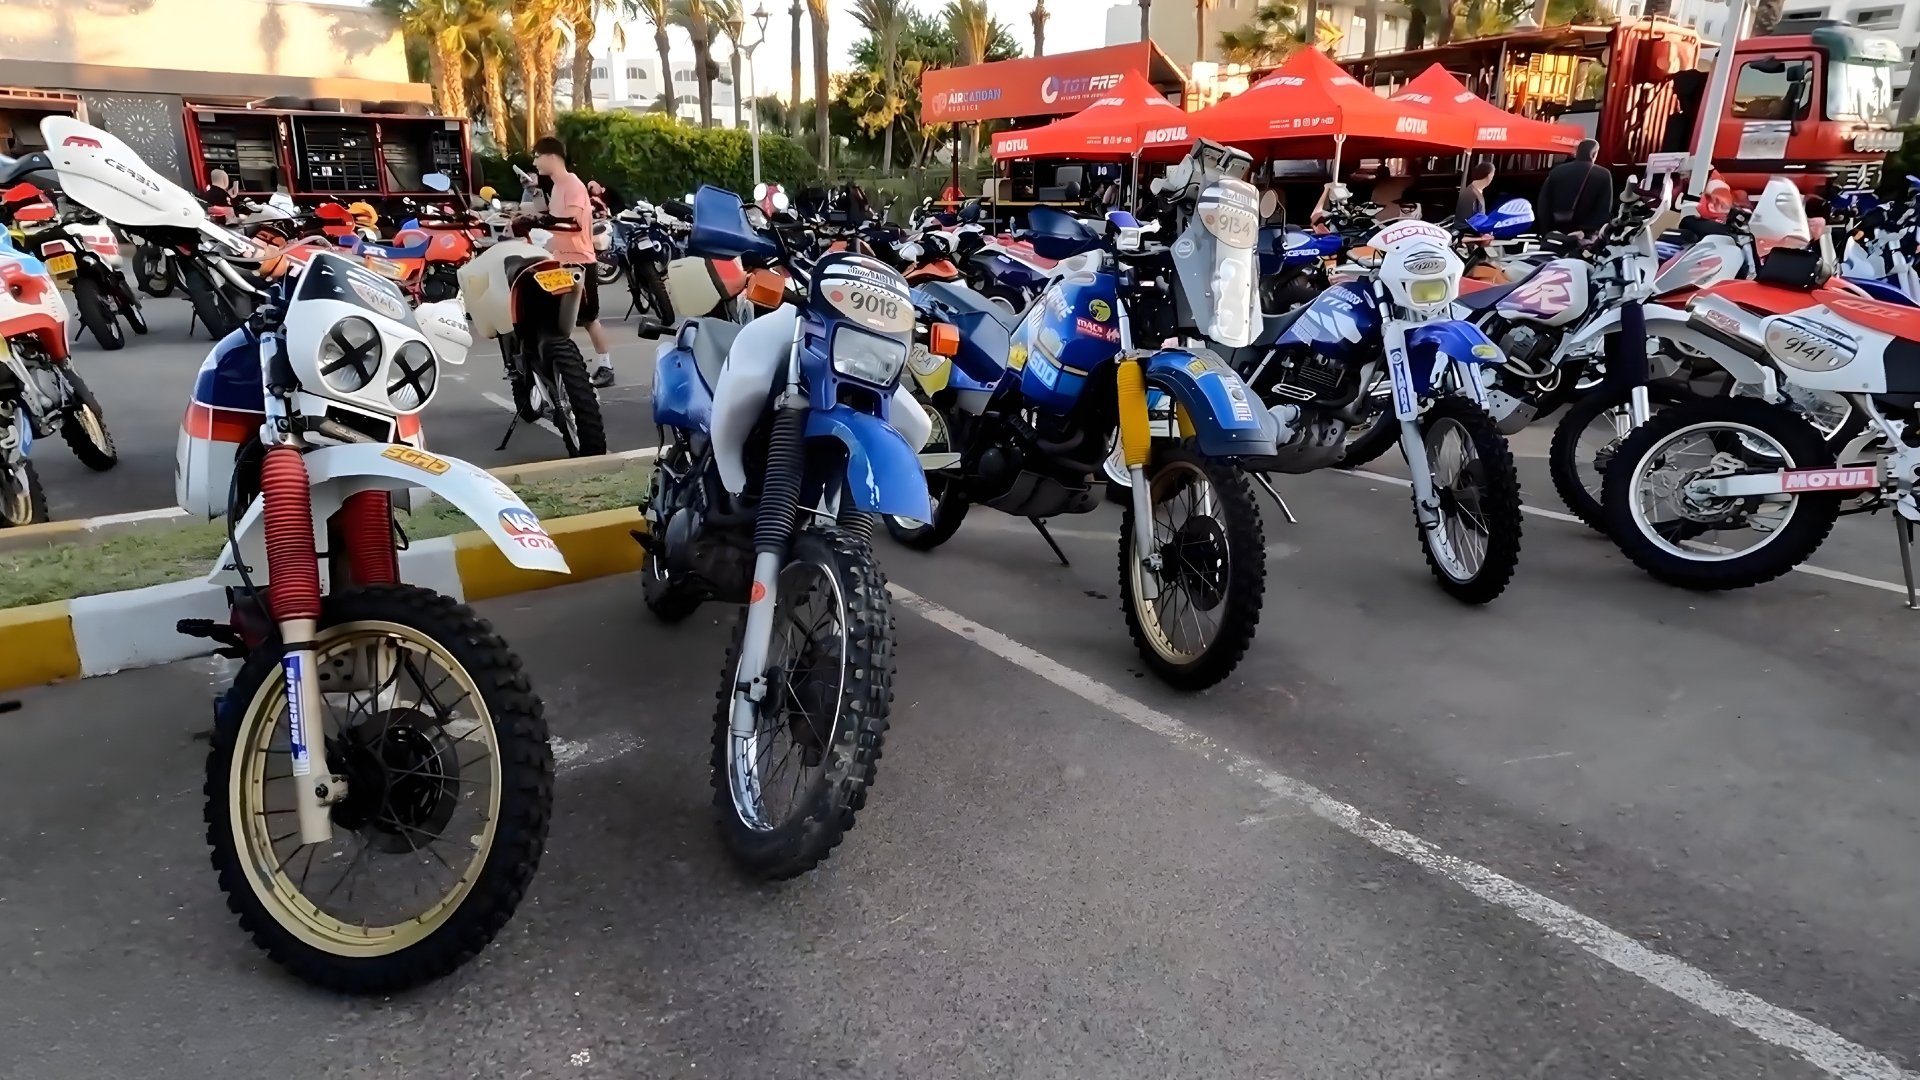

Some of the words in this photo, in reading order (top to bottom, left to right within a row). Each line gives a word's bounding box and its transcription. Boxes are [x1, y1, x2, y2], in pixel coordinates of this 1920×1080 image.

[1395, 116, 1428, 134] MOTUL
[1144, 126, 1188, 143] MOTUL
[997, 138, 1028, 153] MOTUL
[1386, 226, 1446, 243] MOTUL
[850, 291, 898, 320] 9018
[1784, 336, 1826, 362] 9141
[1786, 471, 1869, 489] MOTUL
[286, 667, 300, 745] MICHELIN
